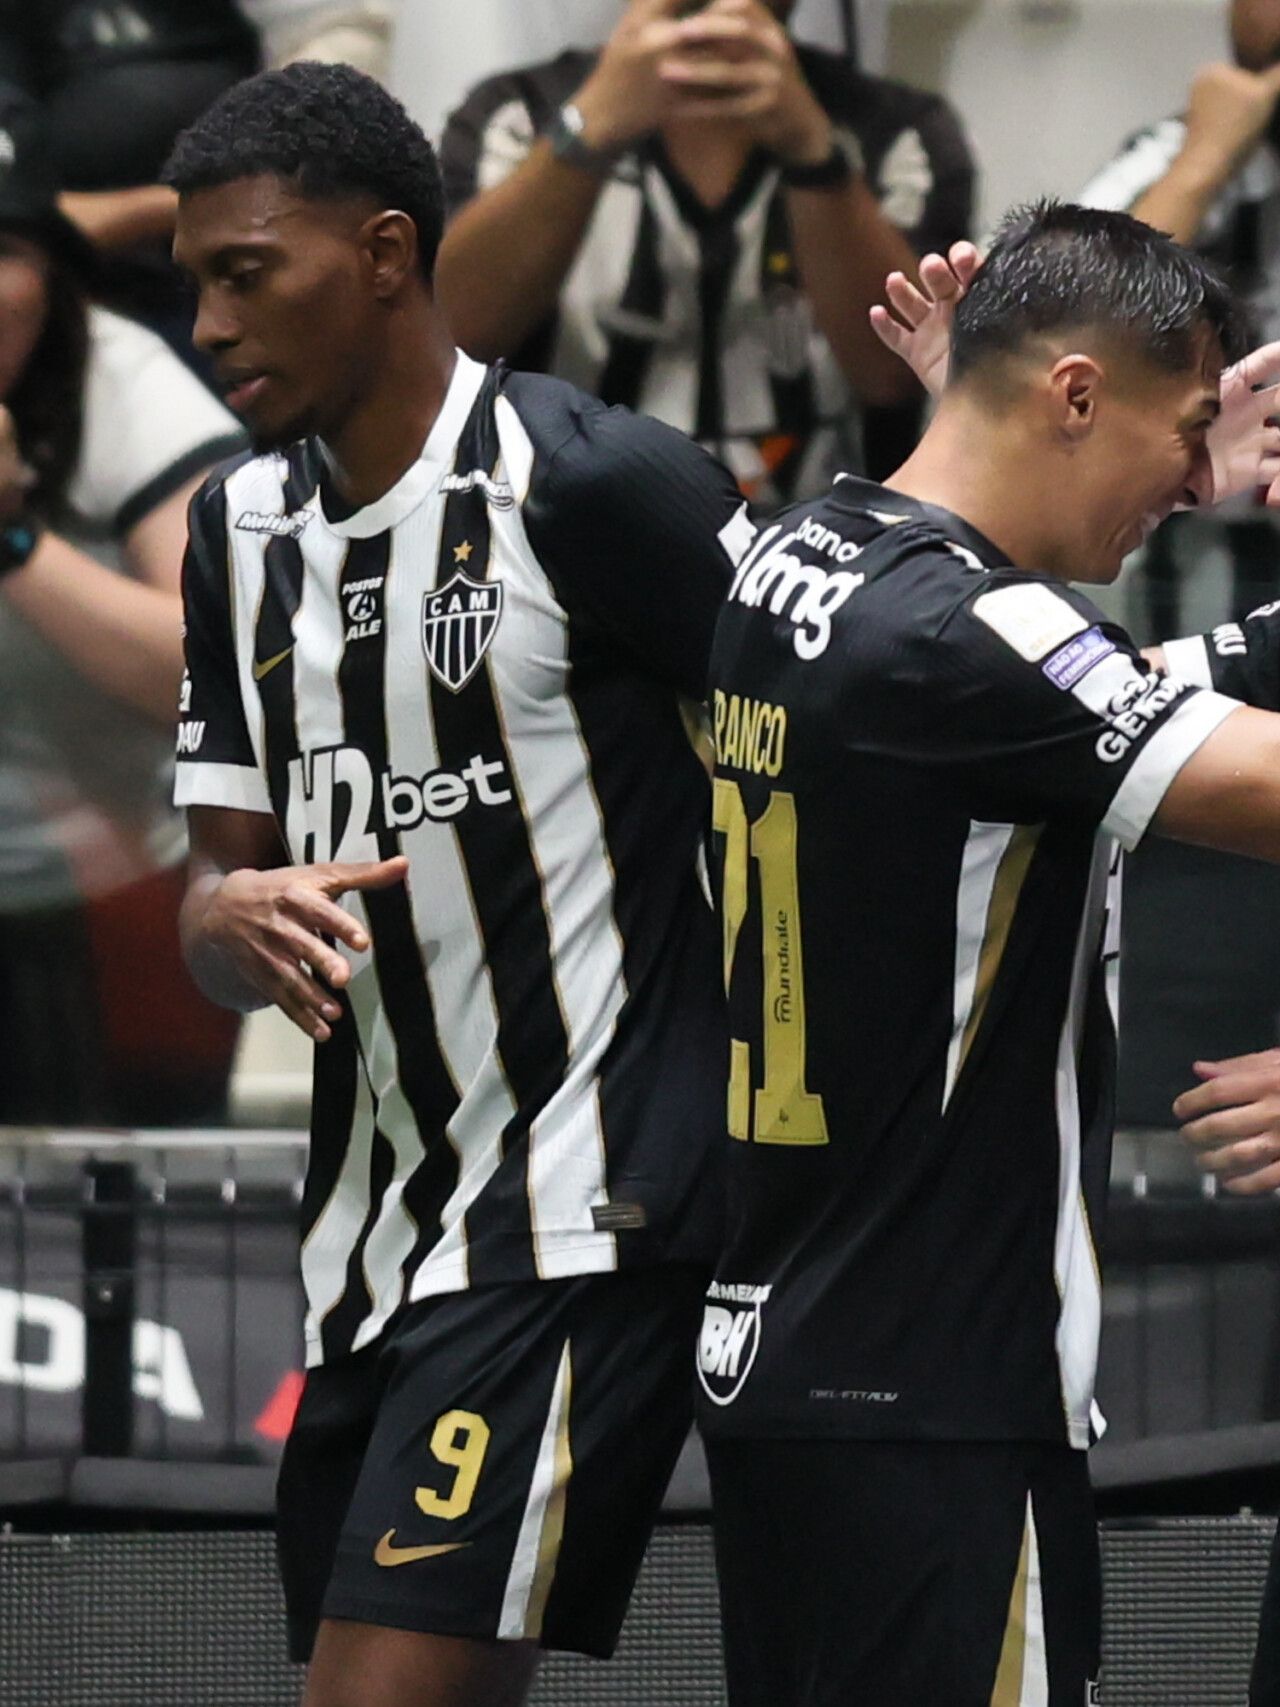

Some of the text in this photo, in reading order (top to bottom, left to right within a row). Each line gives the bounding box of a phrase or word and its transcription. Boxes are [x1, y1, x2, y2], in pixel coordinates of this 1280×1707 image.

[345, 618, 382, 642] ALE
[430, 591, 489, 616] CAM
[714, 688, 787, 777] RANCO
[700, 1304, 756, 1378] BH
[414, 1409, 491, 1521] 9
